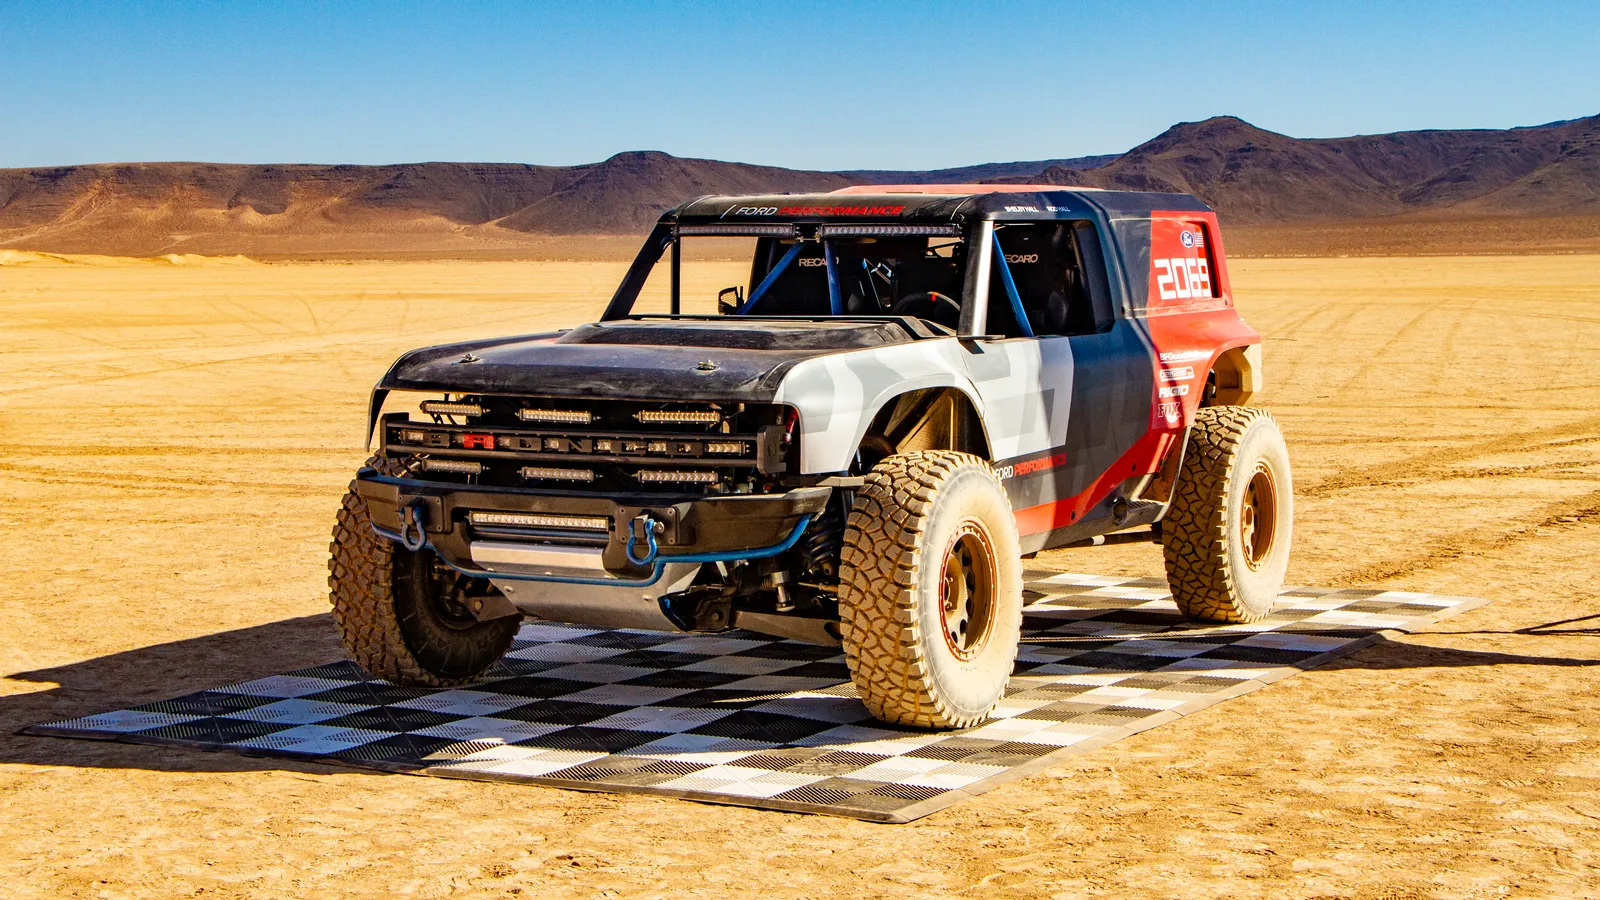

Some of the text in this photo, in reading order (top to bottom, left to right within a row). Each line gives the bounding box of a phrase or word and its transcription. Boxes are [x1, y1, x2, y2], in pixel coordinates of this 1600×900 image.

[735, 205, 906, 216] FORD PERFORMANCE
[798, 257, 840, 267] RECA
[1003, 253, 1039, 264] ECARO
[1154, 258, 1212, 300] 2069
[1157, 401, 1183, 419] FOX
[1013, 452, 1066, 476] PERFORMANCE
